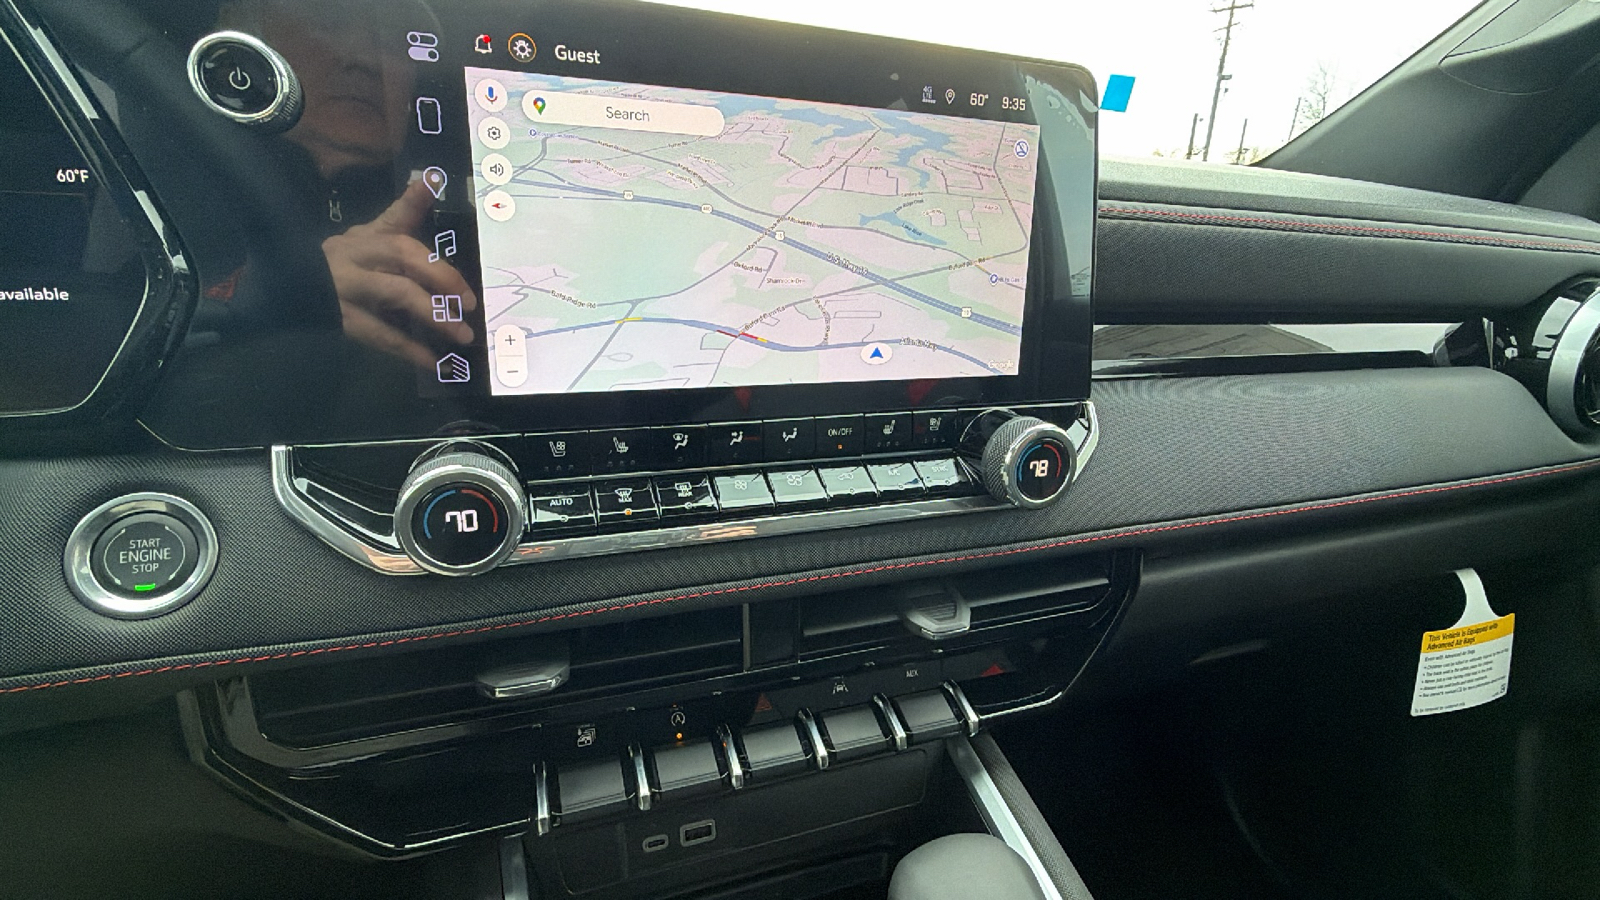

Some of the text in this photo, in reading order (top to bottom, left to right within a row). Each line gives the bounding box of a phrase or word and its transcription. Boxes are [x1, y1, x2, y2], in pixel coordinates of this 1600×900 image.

[554, 44, 601, 65] Guest
[970, 93, 989, 106] 60°
[1001, 96, 1026, 111] 9:35
[604, 105, 650, 123] Search
[56, 168, 89, 183] 60°F
[0, 287, 69, 301] available
[988, 359, 1014, 370] Google
[827, 426, 853, 437] ON/OFF
[1029, 459, 1049, 478] 78
[549, 497, 574, 507] AUTO
[445, 508, 479, 533] 70
[129, 537, 162, 549] START
[118, 547, 173, 565] ENGINE
[131, 562, 160, 575] STOP
[1442, 631, 1461, 640] Vehicle
[1467, 626, 1488, 636] Equipped
[1427, 641, 1454, 650] Advanced
[1463, 637, 1475, 646] Bags
